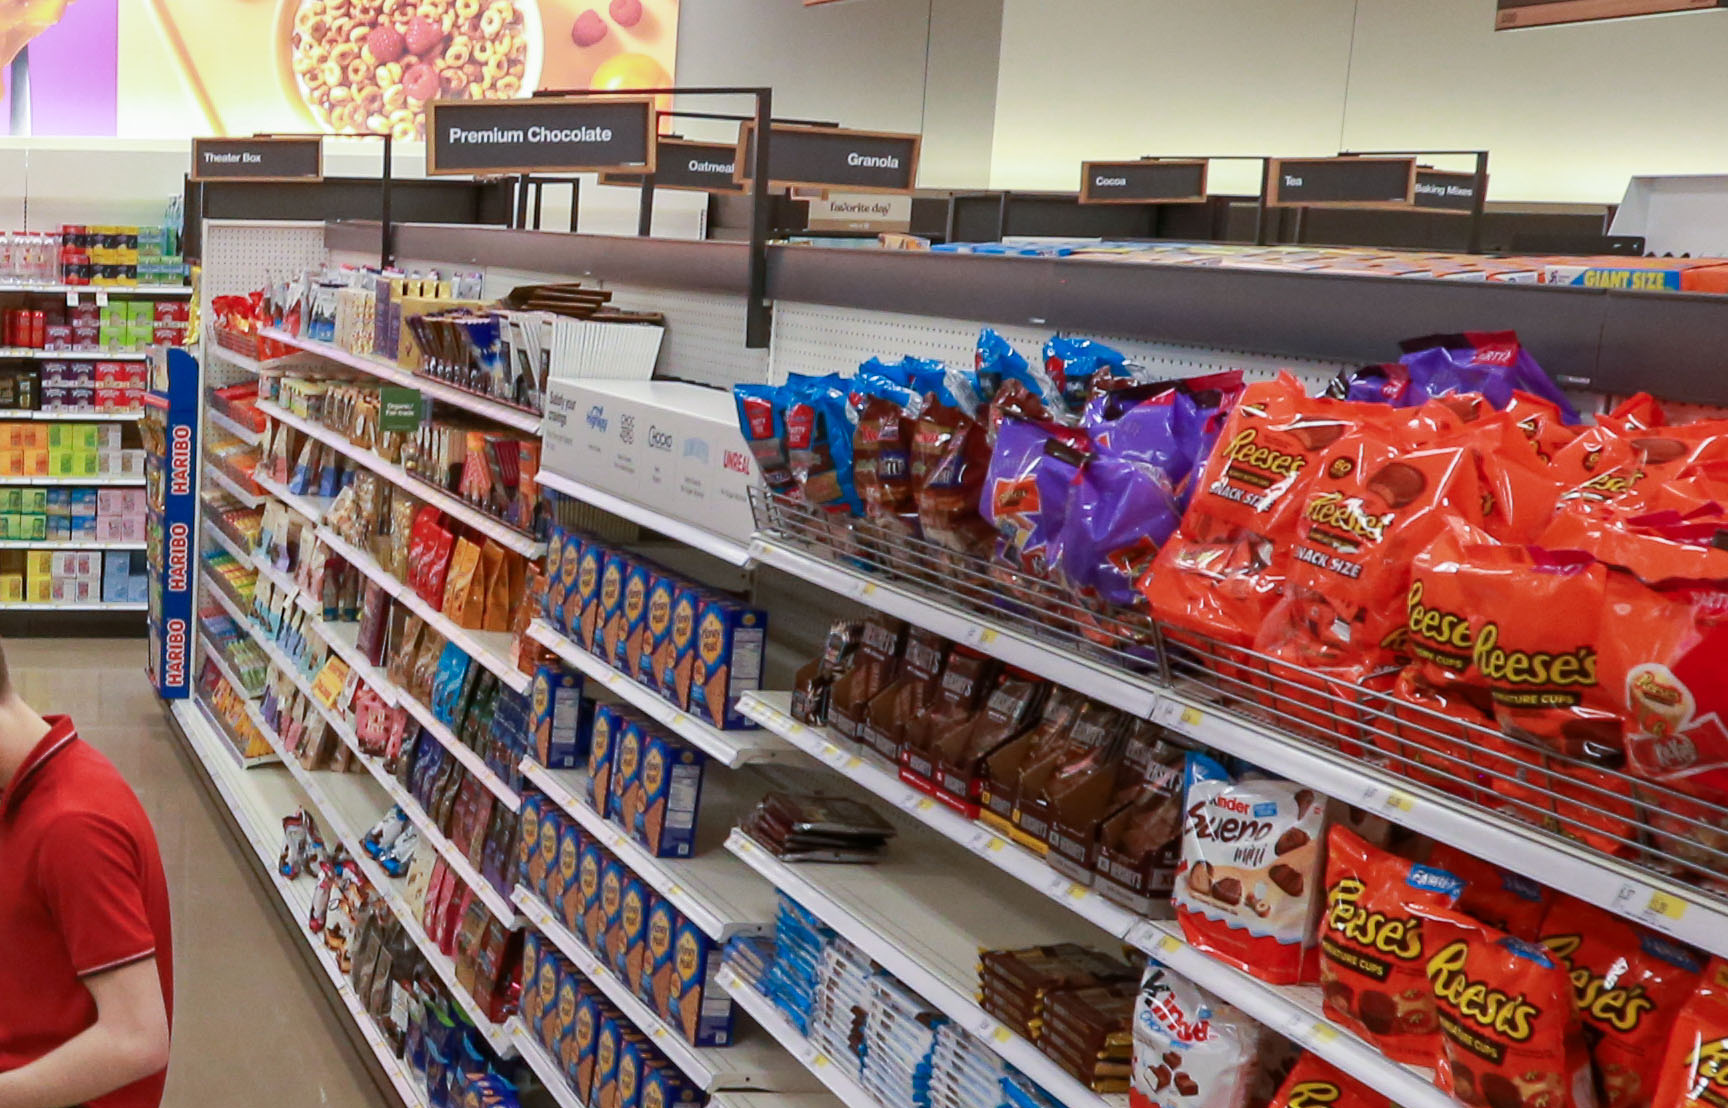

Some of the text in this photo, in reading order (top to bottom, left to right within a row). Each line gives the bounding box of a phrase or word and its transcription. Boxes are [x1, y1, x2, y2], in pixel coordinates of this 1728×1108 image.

[449, 125, 613, 144] Premium Chocolate
[204, 152, 261, 163] Theater Box
[688, 160, 735, 174] Oatmeal
[847, 152, 900, 169] Granola
[1096, 176, 1126, 187] Cocoa
[1285, 176, 1303, 187] Tea
[1415, 183, 1473, 197] Baking Mixes
[829, 202, 871, 214] favorite
[1584, 270, 1666, 290] GIANT SIZE
[171, 424, 191, 495] HARIBO
[723, 449, 751, 476] UNREAL
[1221, 427, 1308, 482] Reese's
[169, 523, 189, 591] HARIBO
[1330, 556, 1362, 578] SIZE
[166, 619, 186, 687] HARIBO
[1473, 624, 1598, 686] Reese's
[1233, 843, 1266, 867] mini
[1328, 877, 1426, 961] Reese's
[1426, 940, 1539, 1042] Reese's
